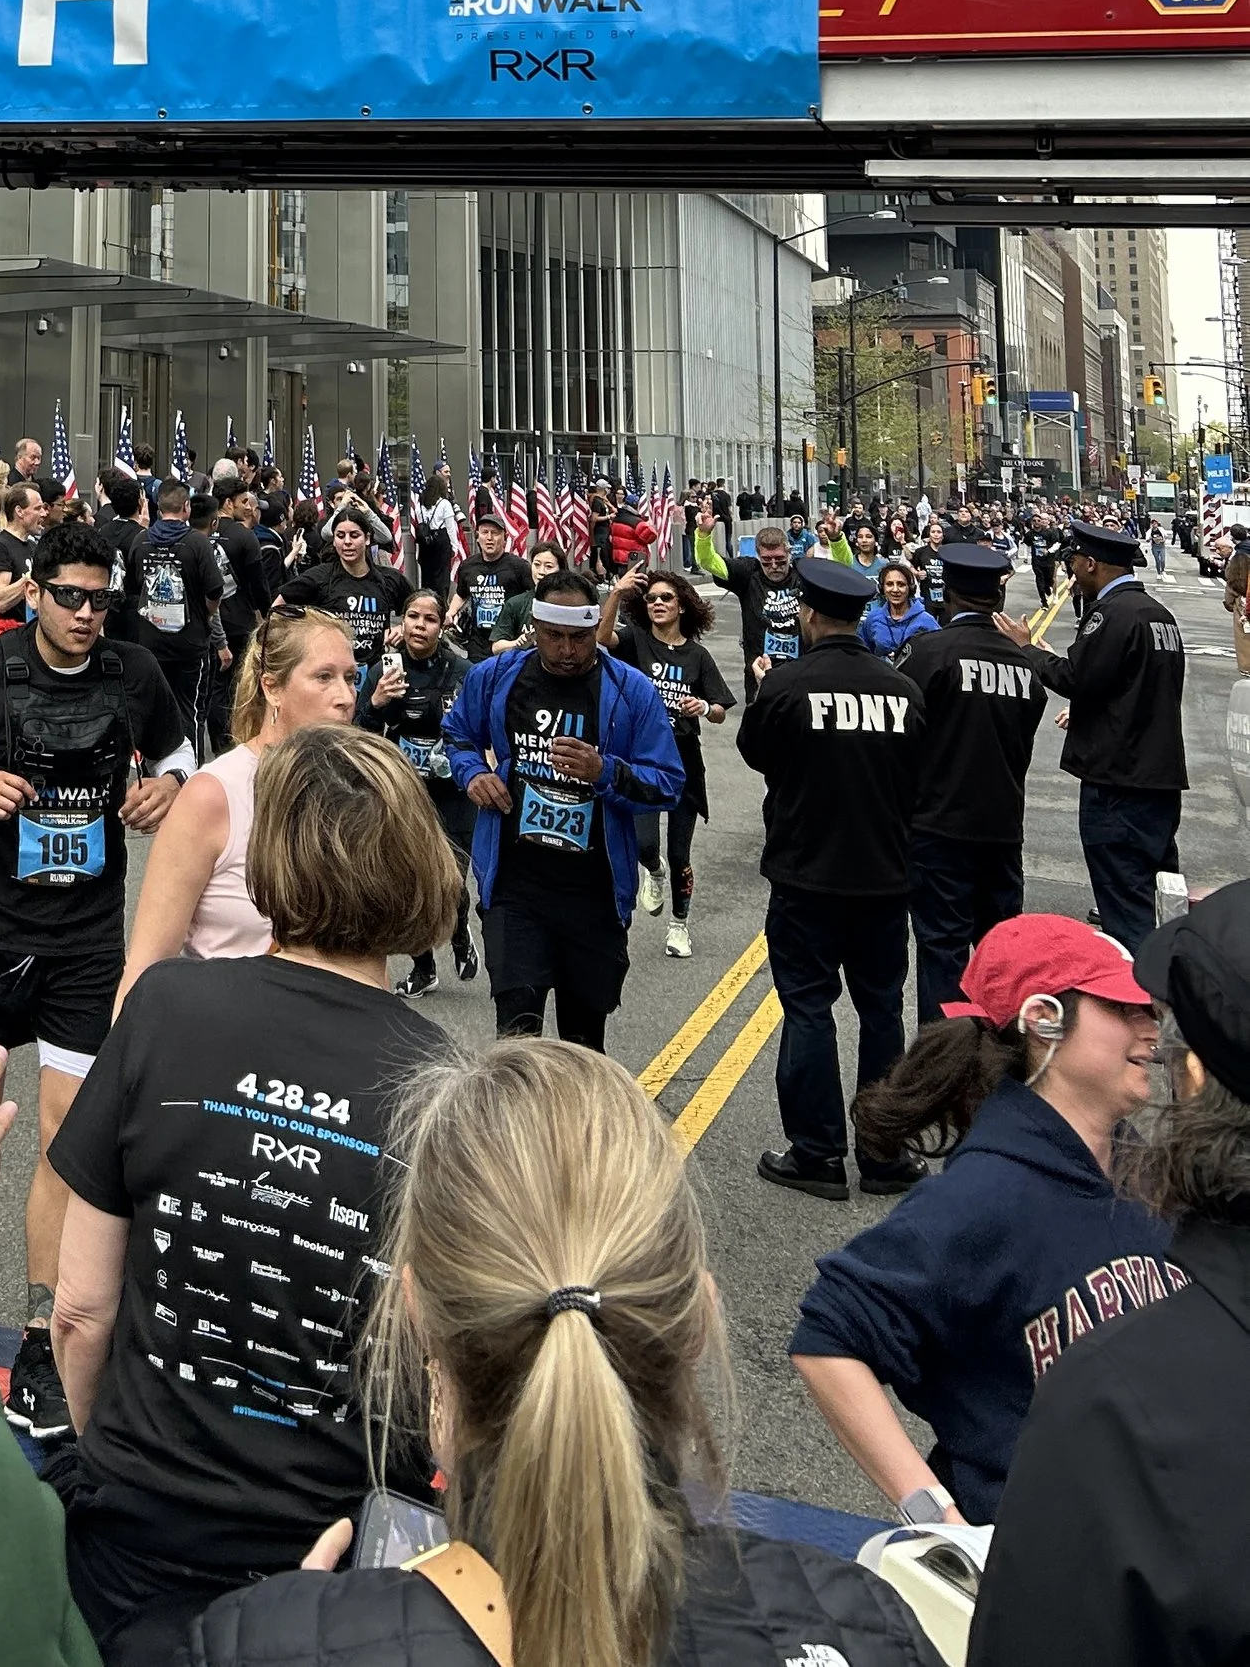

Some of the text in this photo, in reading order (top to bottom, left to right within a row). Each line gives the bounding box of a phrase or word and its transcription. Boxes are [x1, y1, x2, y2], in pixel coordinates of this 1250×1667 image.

[456, 29, 636, 41] PRESENTED BY
[489, 48, 598, 82] RXR
[477, 574, 497, 586] 9/11
[347, 595, 377, 613] 9/11
[767, 638, 797, 653] 2263
[1150, 621, 1182, 652] FDNY
[647, 677, 691, 694] MORIAL
[651, 662, 683, 681] 9/11
[959, 658, 1032, 700] FDNY
[535, 709, 584, 738] 9/11
[807, 692, 909, 733] FDNY
[526, 800, 586, 836] 2523
[37, 833, 88, 865] 195
[50, 873, 76, 883] RUNNER
[236, 1073, 350, 1125] 4.28.24
[203, 1099, 380, 1157] THANK YOU TO OUR SPONSORS
[251, 1132, 321, 1175] RXR
[329, 1197, 370, 1232] fiserv.
[293, 1234, 345, 1261] Brookfield
[315, 1285, 331, 1296] BLUE
